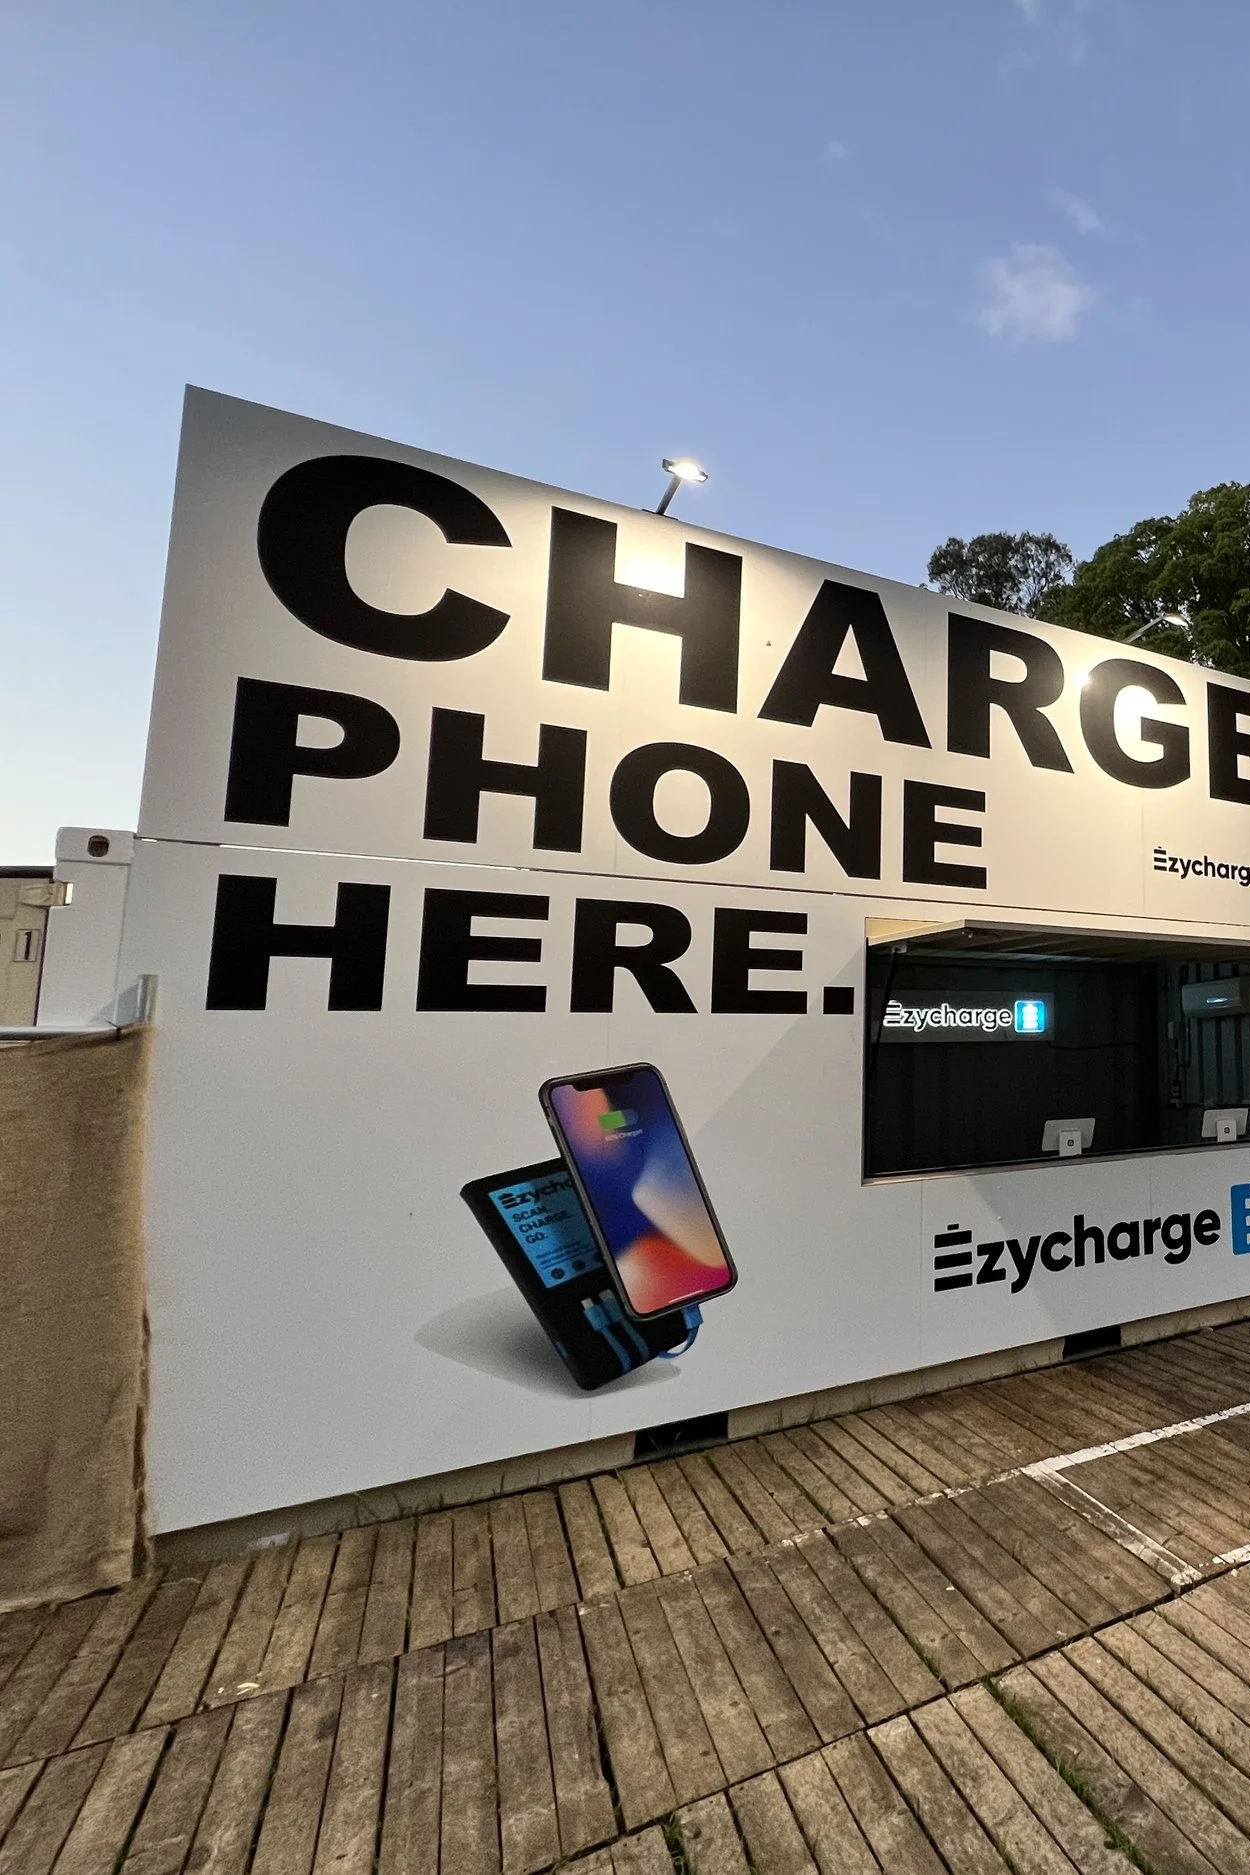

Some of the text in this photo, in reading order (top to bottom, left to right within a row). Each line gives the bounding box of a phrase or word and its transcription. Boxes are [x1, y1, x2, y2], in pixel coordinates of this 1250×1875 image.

[224, 676, 987, 889] PHONE
[205, 874, 855, 1015] HERE.
[883, 1000, 1013, 1032] Ezycharge
[934, 1208, 1221, 1294] Ezycharge
